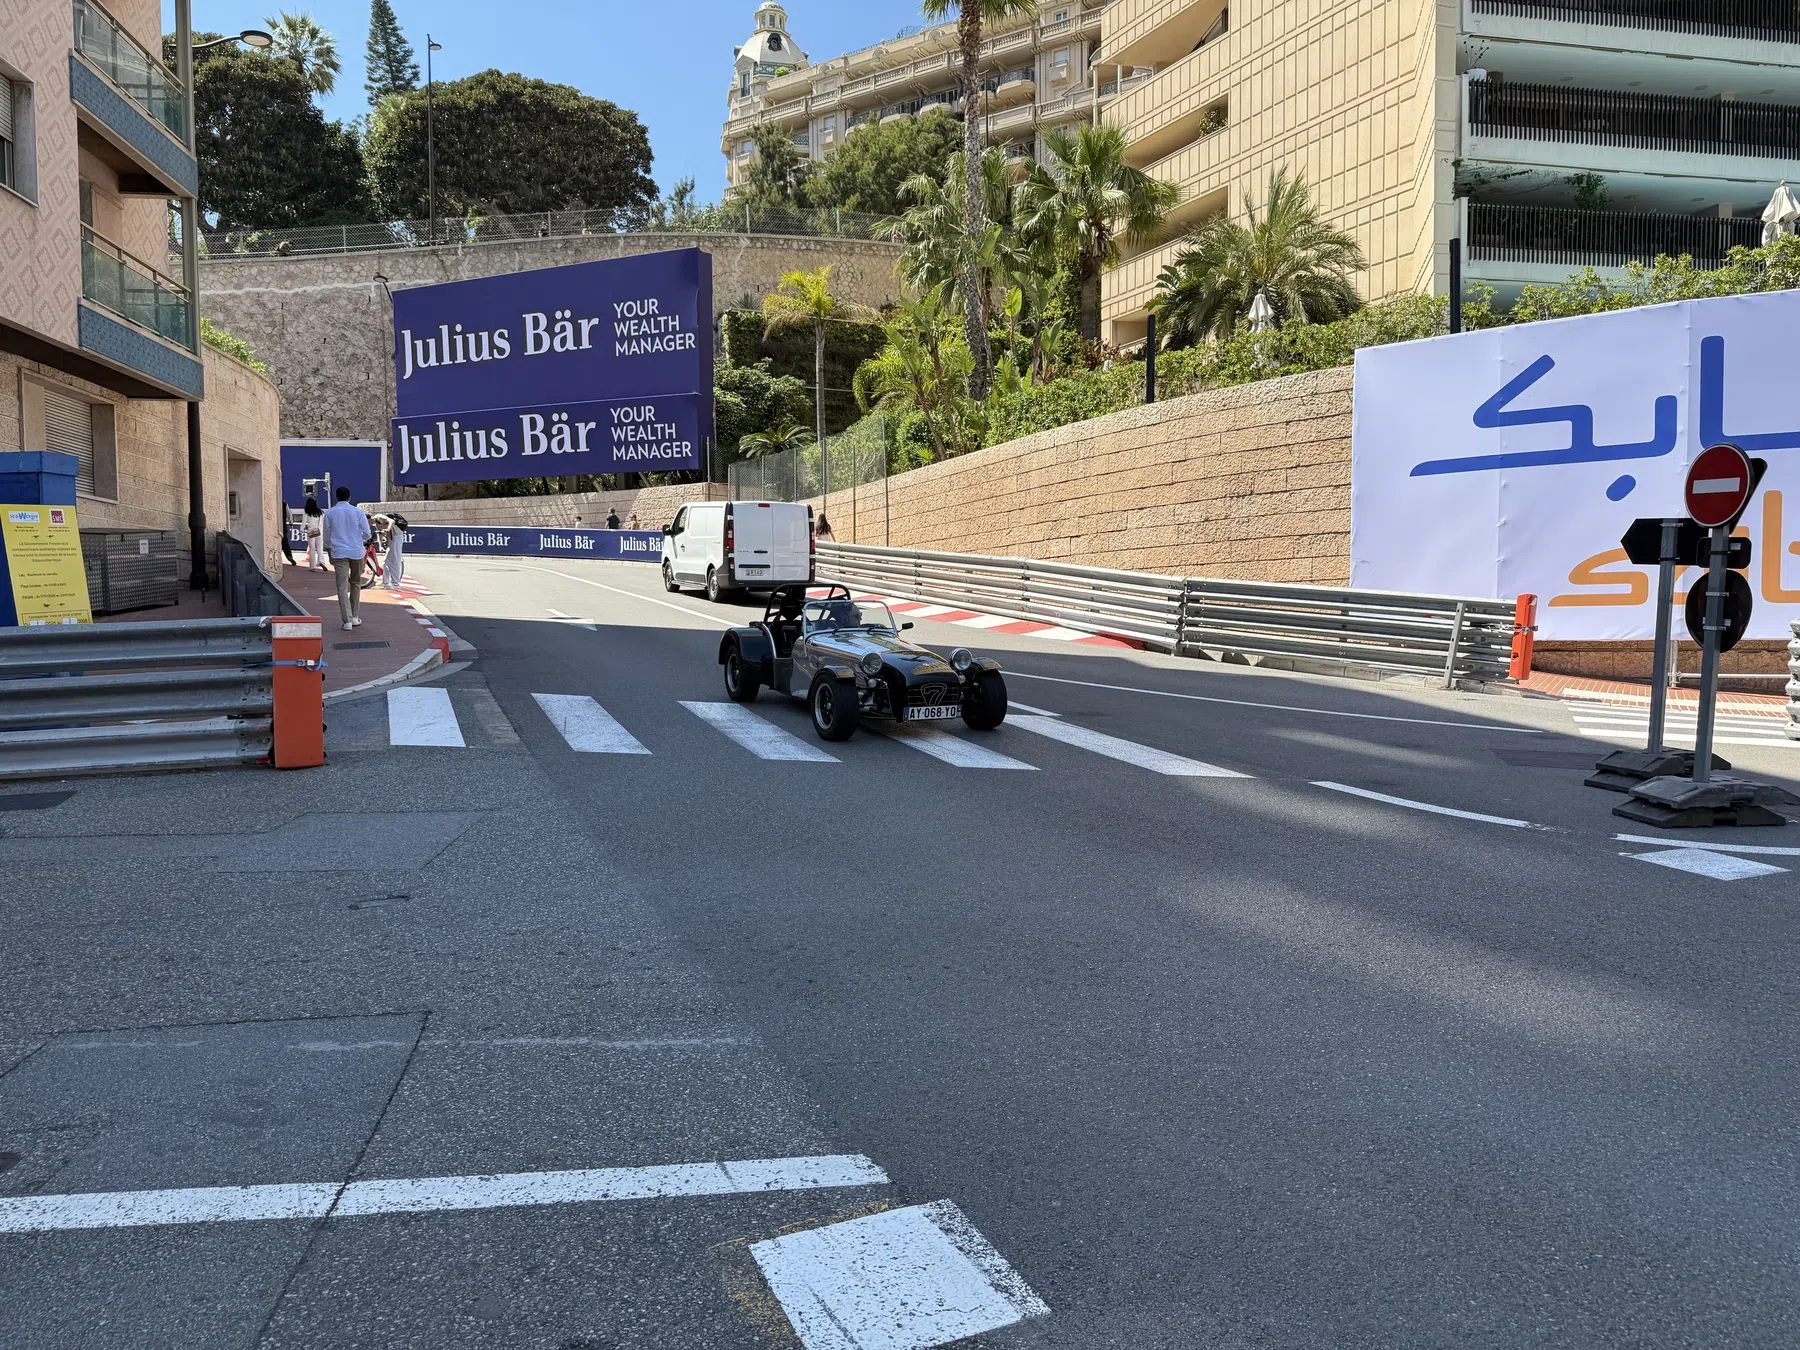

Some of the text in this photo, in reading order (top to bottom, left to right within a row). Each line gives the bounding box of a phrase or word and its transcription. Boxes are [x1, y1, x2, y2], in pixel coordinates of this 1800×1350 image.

[613, 298, 658, 318] YOUR
[614, 315, 680, 337] WEALTH
[401, 310, 599, 379] Julius Bär
[615, 333, 696, 357] MANAGER
[610, 405, 656, 424] YOUR
[611, 423, 676, 442] WEALTH
[398, 412, 597, 475] Julius Bär
[613, 440, 693, 461] MANAGER
[290, 528, 307, 542] Bä
[446, 533, 511, 549] Julius Bär
[540, 534, 596, 551] Julius Bär
[619, 536, 648, 554] Julius
